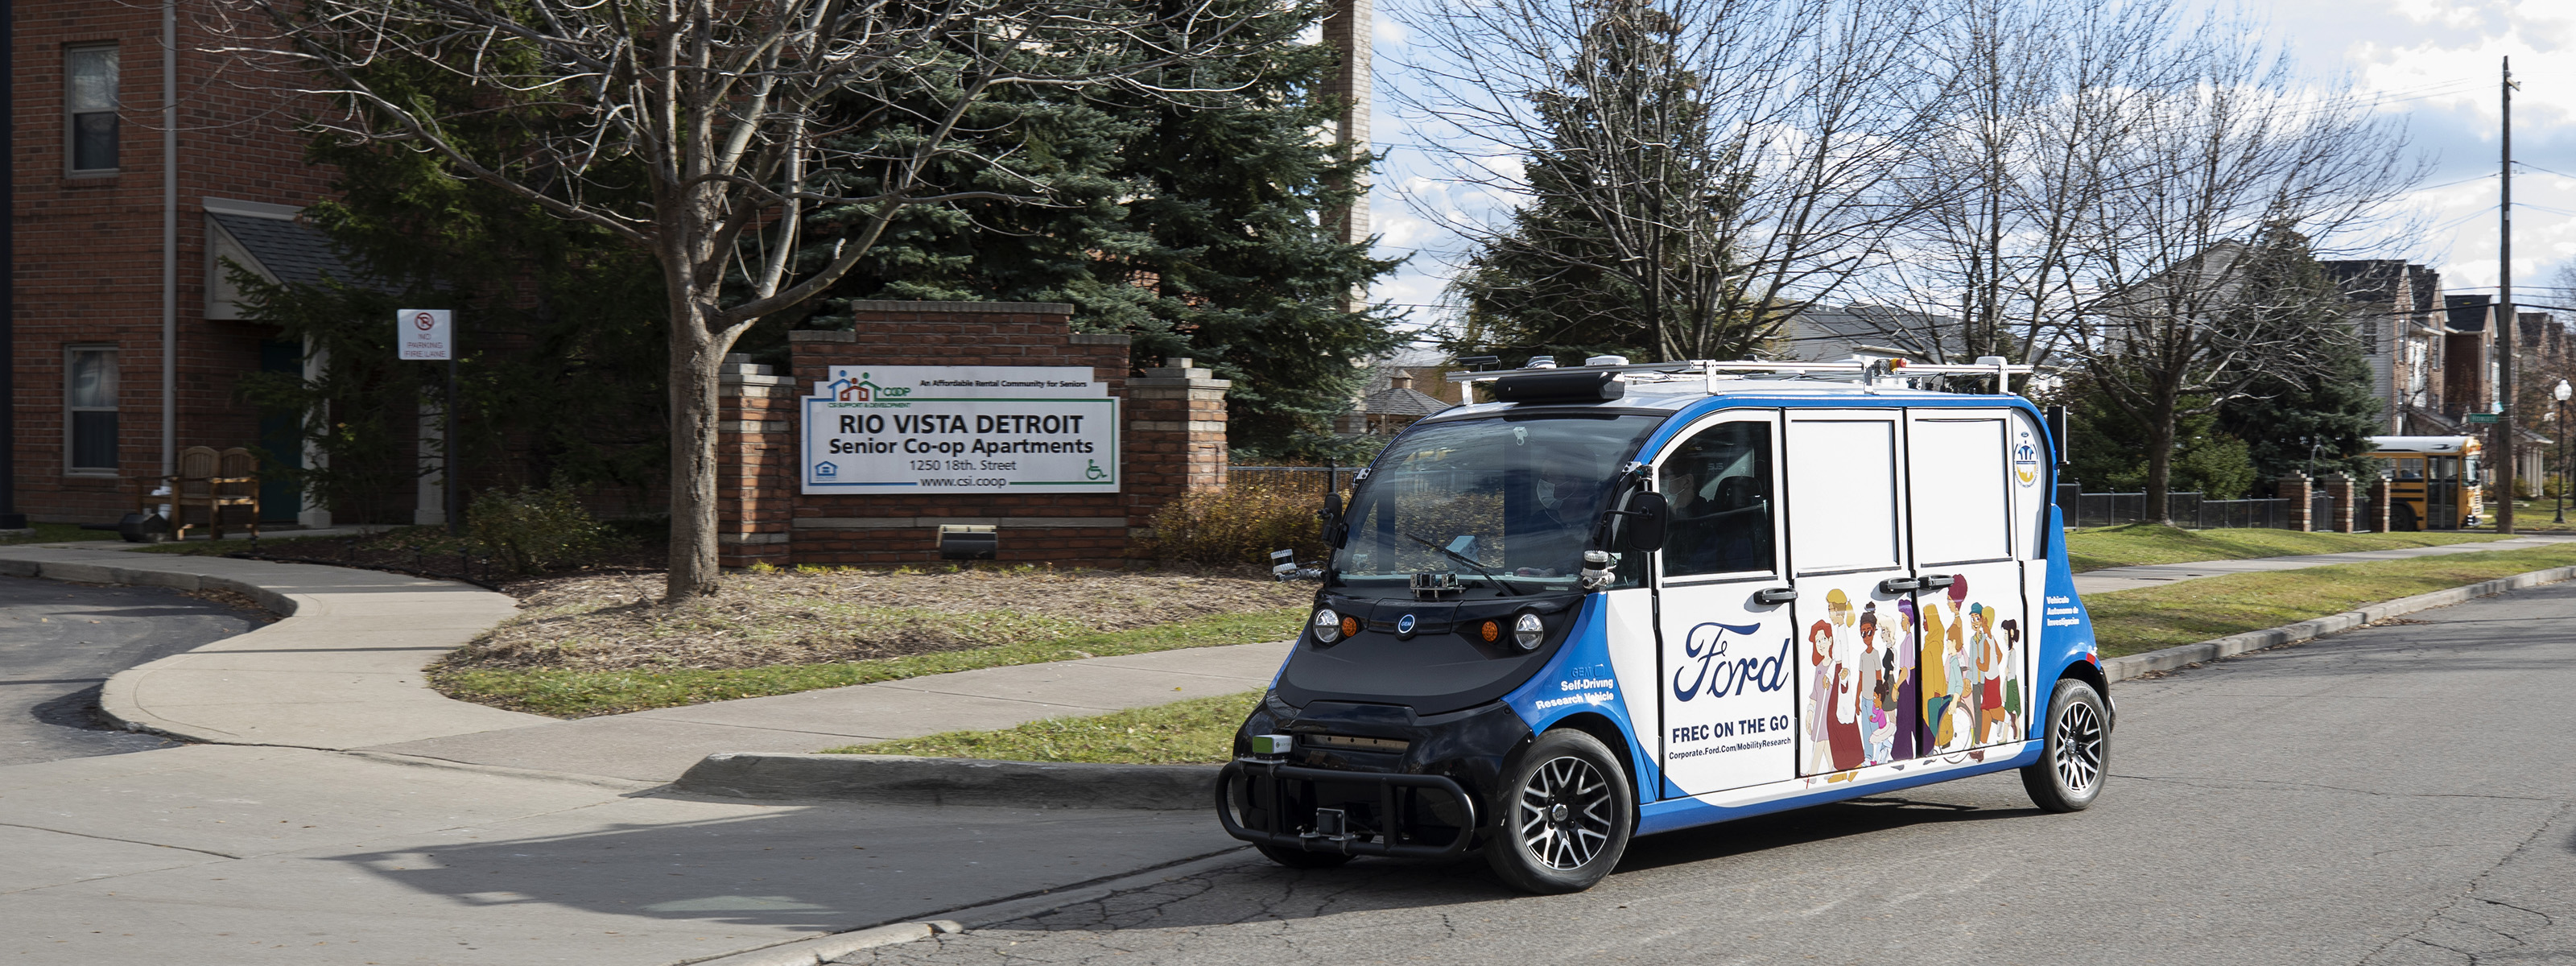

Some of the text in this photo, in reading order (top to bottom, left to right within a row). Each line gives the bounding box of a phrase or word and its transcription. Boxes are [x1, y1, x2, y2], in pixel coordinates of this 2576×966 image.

[932, 379, 973, 387] Affordable
[1001, 380, 1045, 389] Community
[840, 415, 1084, 434] RIO VISTA DETROIT
[829, 438, 1094, 457] Senior Co-op Apartments
[910, 460, 1017, 471] 1250 18th. Street
[920, 477, 1007, 489] www.csi.coop
[2073, 605, 2079, 614] de
[1674, 622, 1790, 702] Ford
[1561, 678, 1613, 691] Self-Driving
[1535, 691, 1614, 710] Research Vehicle
[1673, 715, 1789, 743] FREC ON THE GO
[1669, 737, 1791, 760] Corporate.Ford.Com/MobilityResearch
